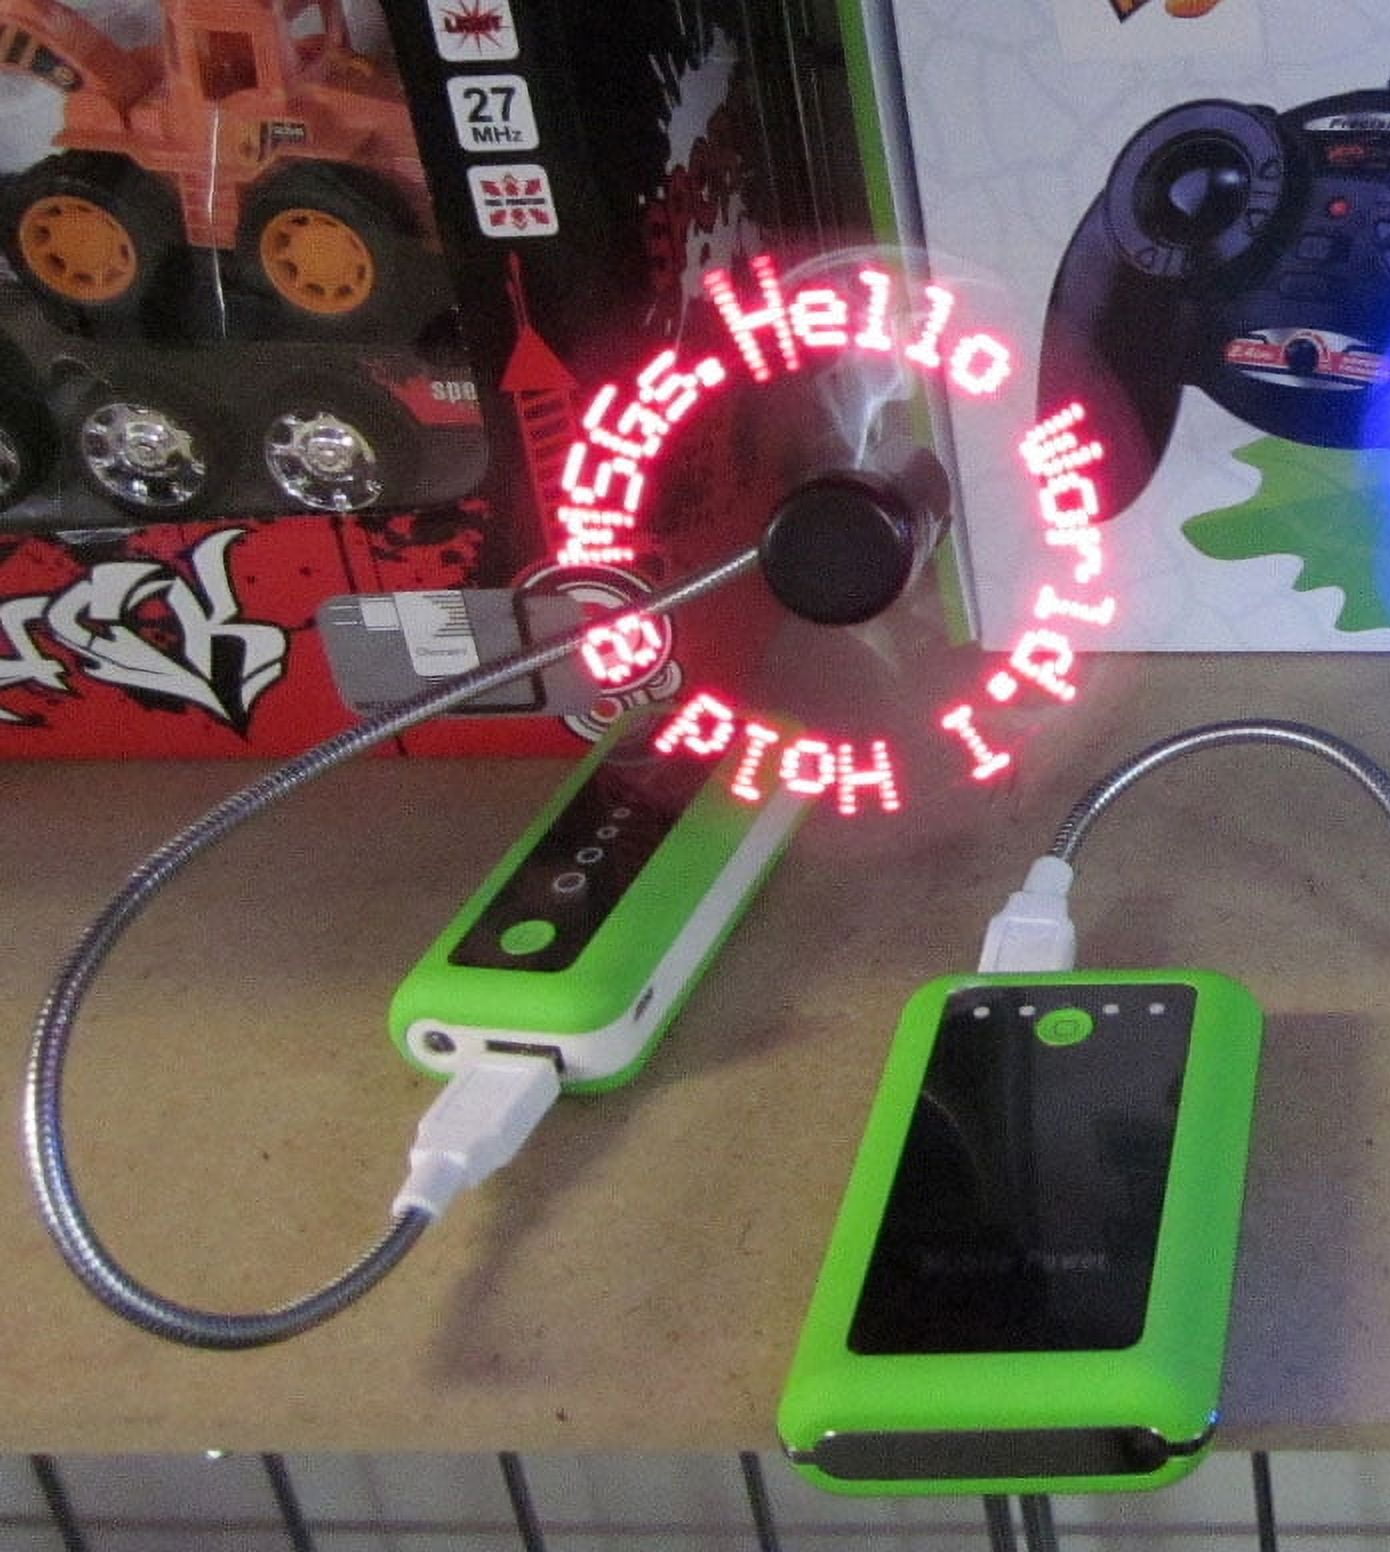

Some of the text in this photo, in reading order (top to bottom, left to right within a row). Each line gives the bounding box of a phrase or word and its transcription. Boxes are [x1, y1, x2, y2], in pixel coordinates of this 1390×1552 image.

[463, 86, 516, 122] 27
[470, 126, 523, 144] MHz
[703, 254, 1012, 395] Hello
[556, 349, 727, 567] MSGs.
[579, 612, 664, 683] 8
[654, 693, 901, 814] Hold
